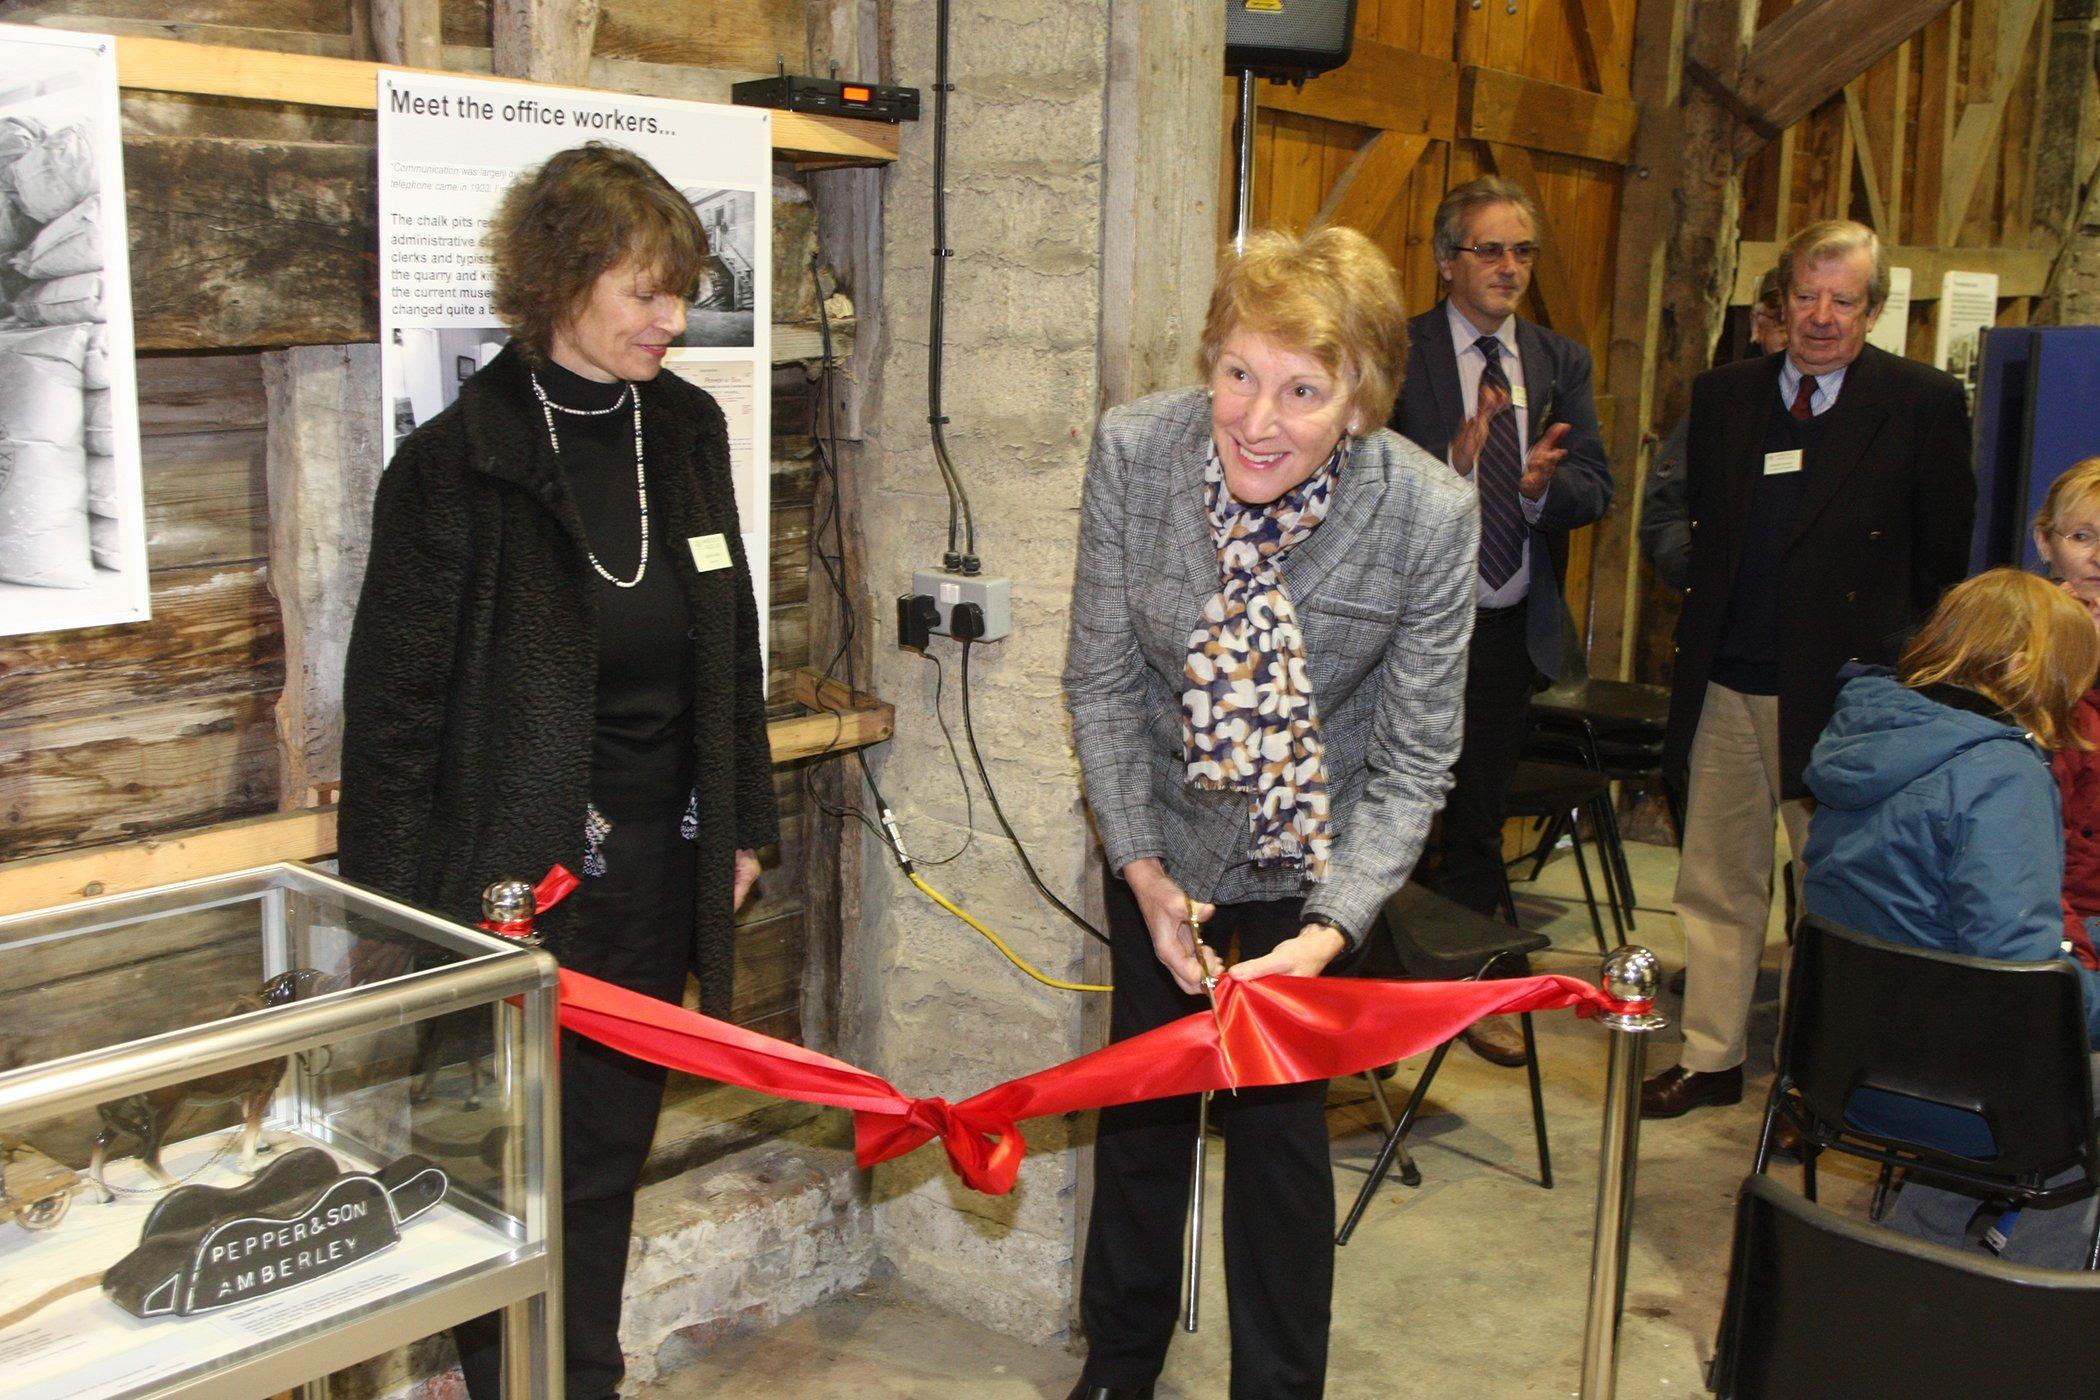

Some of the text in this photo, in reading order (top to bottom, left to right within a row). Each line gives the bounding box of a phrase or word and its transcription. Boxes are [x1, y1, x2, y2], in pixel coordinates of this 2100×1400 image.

[391, 89, 676, 136] Meet the office workers...
[390, 180, 432, 191] telephone
[435, 183, 457, 192] came
[391, 213, 412, 226] The
[417, 214, 448, 227] chalk
[452, 216, 473, 229] pits
[391, 233, 475, 247] administrative
[391, 252, 427, 263] clerks
[431, 253, 452, 264] and
[391, 269, 410, 280] the
[414, 270, 451, 283] quarry
[456, 270, 477, 281] and
[392, 286, 496, 298] the current muse
[392, 303, 442, 317] changed
[447, 304, 475, 317] quite
[479, 306, 485, 315] a
[218, 1235, 358, 1298] AMBERLEY
